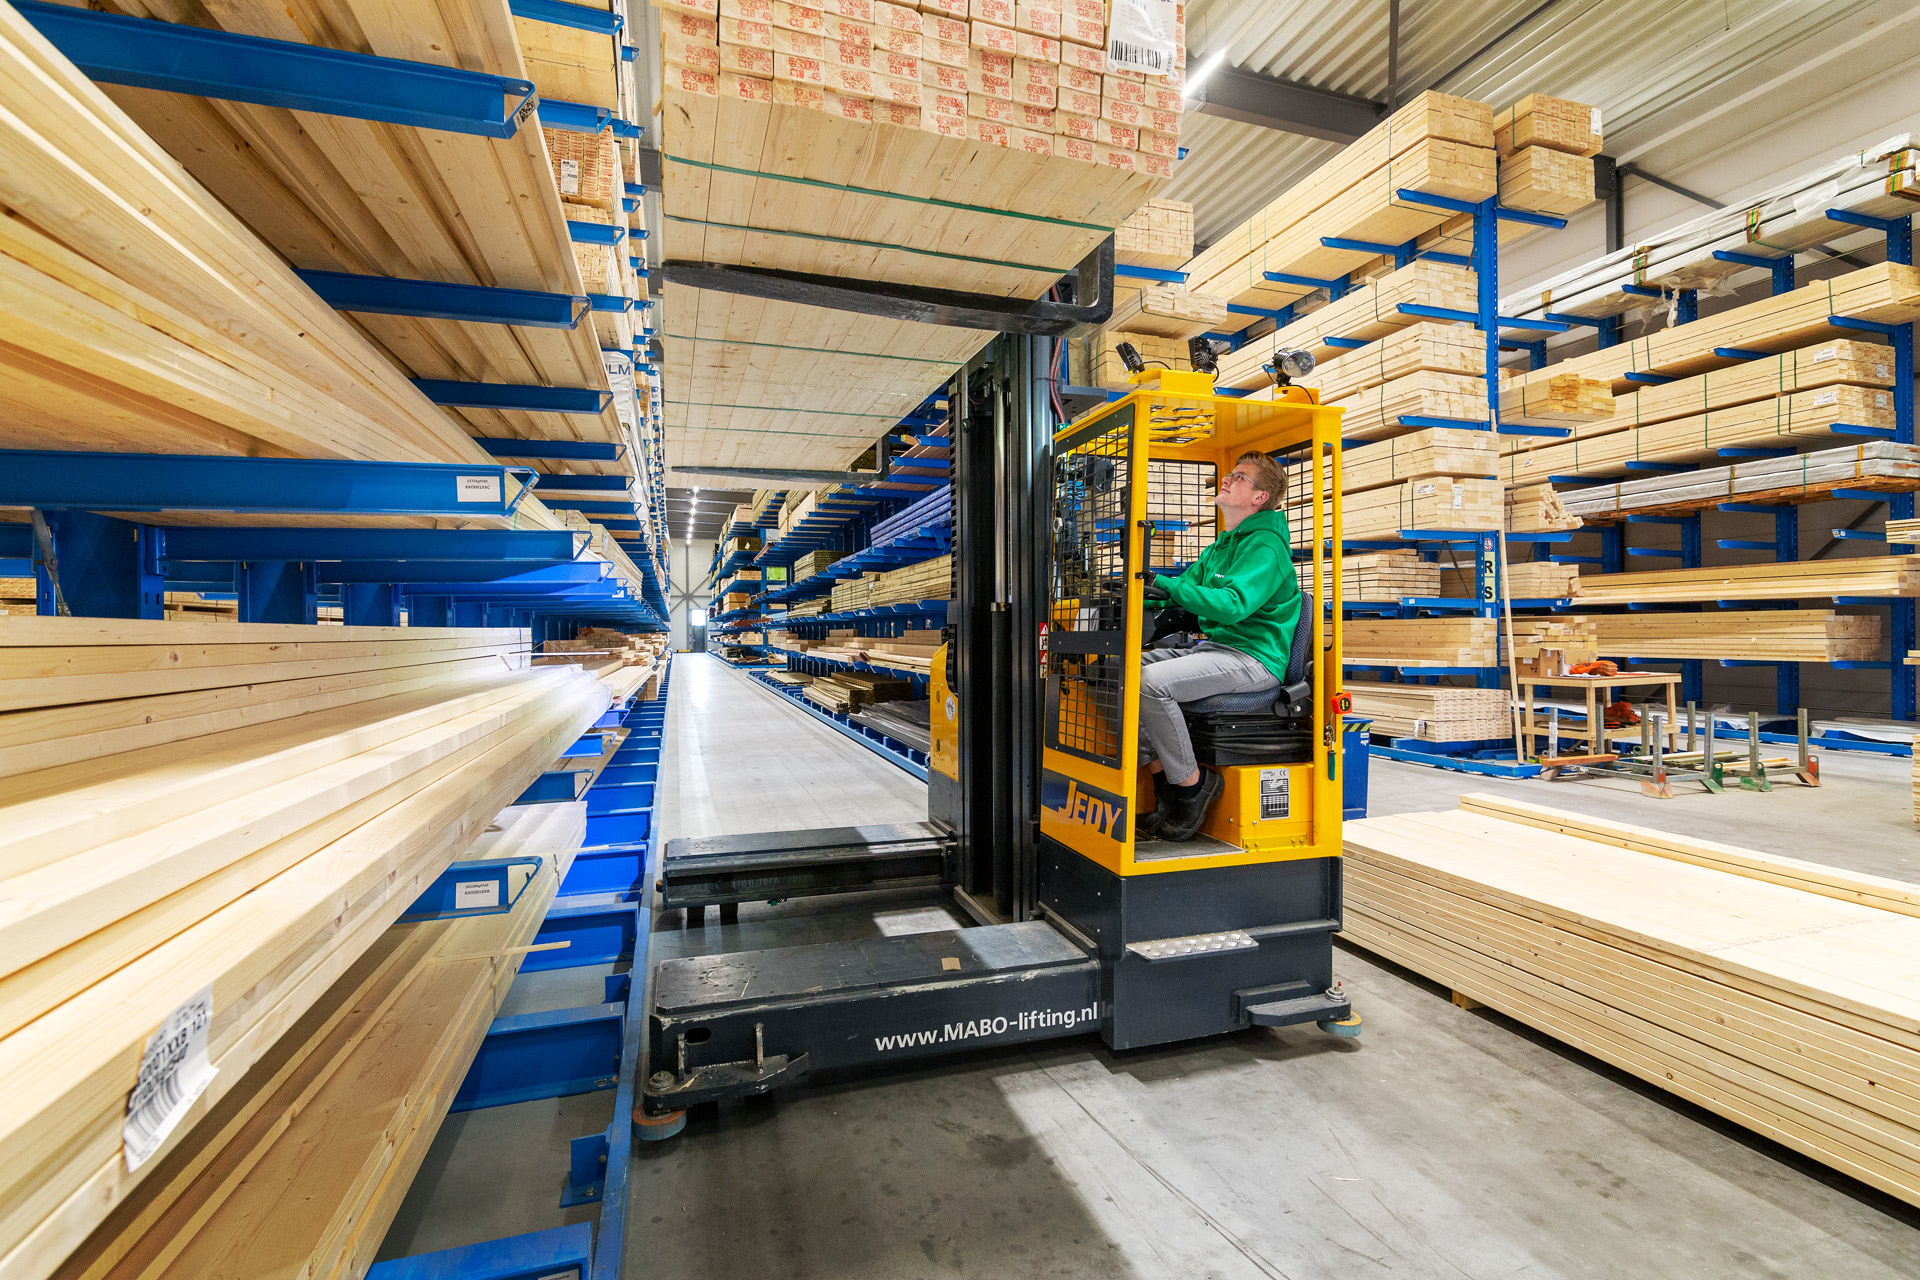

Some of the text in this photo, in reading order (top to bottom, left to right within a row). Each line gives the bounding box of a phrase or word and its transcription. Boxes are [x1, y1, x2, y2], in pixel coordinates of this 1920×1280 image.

[741, 8, 755, 18] C18
[841, 6, 854, 16] C18
[983, 10, 995, 18] C18
[1078, 8, 1089, 16] C18
[790, 19, 804, 27] C18
[891, 19, 905, 28] C18
[1031, 22, 1044, 30] C18
[681, 26, 697, 36] C18
[939, 30, 952, 39] C18
[1078, 30, 1090, 39] C18
[738, 31, 752, 41] C18
[842, 34, 854, 43] C18
[988, 39, 1001, 47] C18
[686, 55, 701, 66] C18
[739, 59, 753, 69] C18
[840, 55, 854, 64] C18
[1078, 59, 1091, 68] C18
[890, 65, 903, 75] C18
[982, 63, 995, 72] C18
[790, 69, 804, 78] C18
[939, 78, 952, 87] C18
[1030, 75, 1042, 84] C18
[1070, 79, 1082, 87] C18
[683, 81, 698, 91] C18
[983, 85, 996, 94] C18
[739, 89, 754, 99] C18
[1028, 94, 1041, 103] C18
[1119, 92, 1131, 100] C18
[1073, 102, 1085, 110] C18
[1158, 101, 1169, 109] C18
[843, 109, 857, 117] C18
[986, 109, 999, 118] C18
[1112, 112, 1123, 120] C18
[892, 114, 904, 123] C18
[1026, 115, 1038, 124] C18
[938, 125, 950, 134] C18
[1154, 122, 1165, 130] C18
[981, 134, 993, 142] C18
[1112, 136, 1123, 144] C18
[1153, 143, 1163, 153] C18
[1068, 150, 1079, 159] C18
[1484, 560, 1493, 574] R
[1484, 585, 1493, 600] S
[1058, 780, 1123, 838] JEDY
[875, 1002, 1098, 1052] www.MABO-lifting.nl
